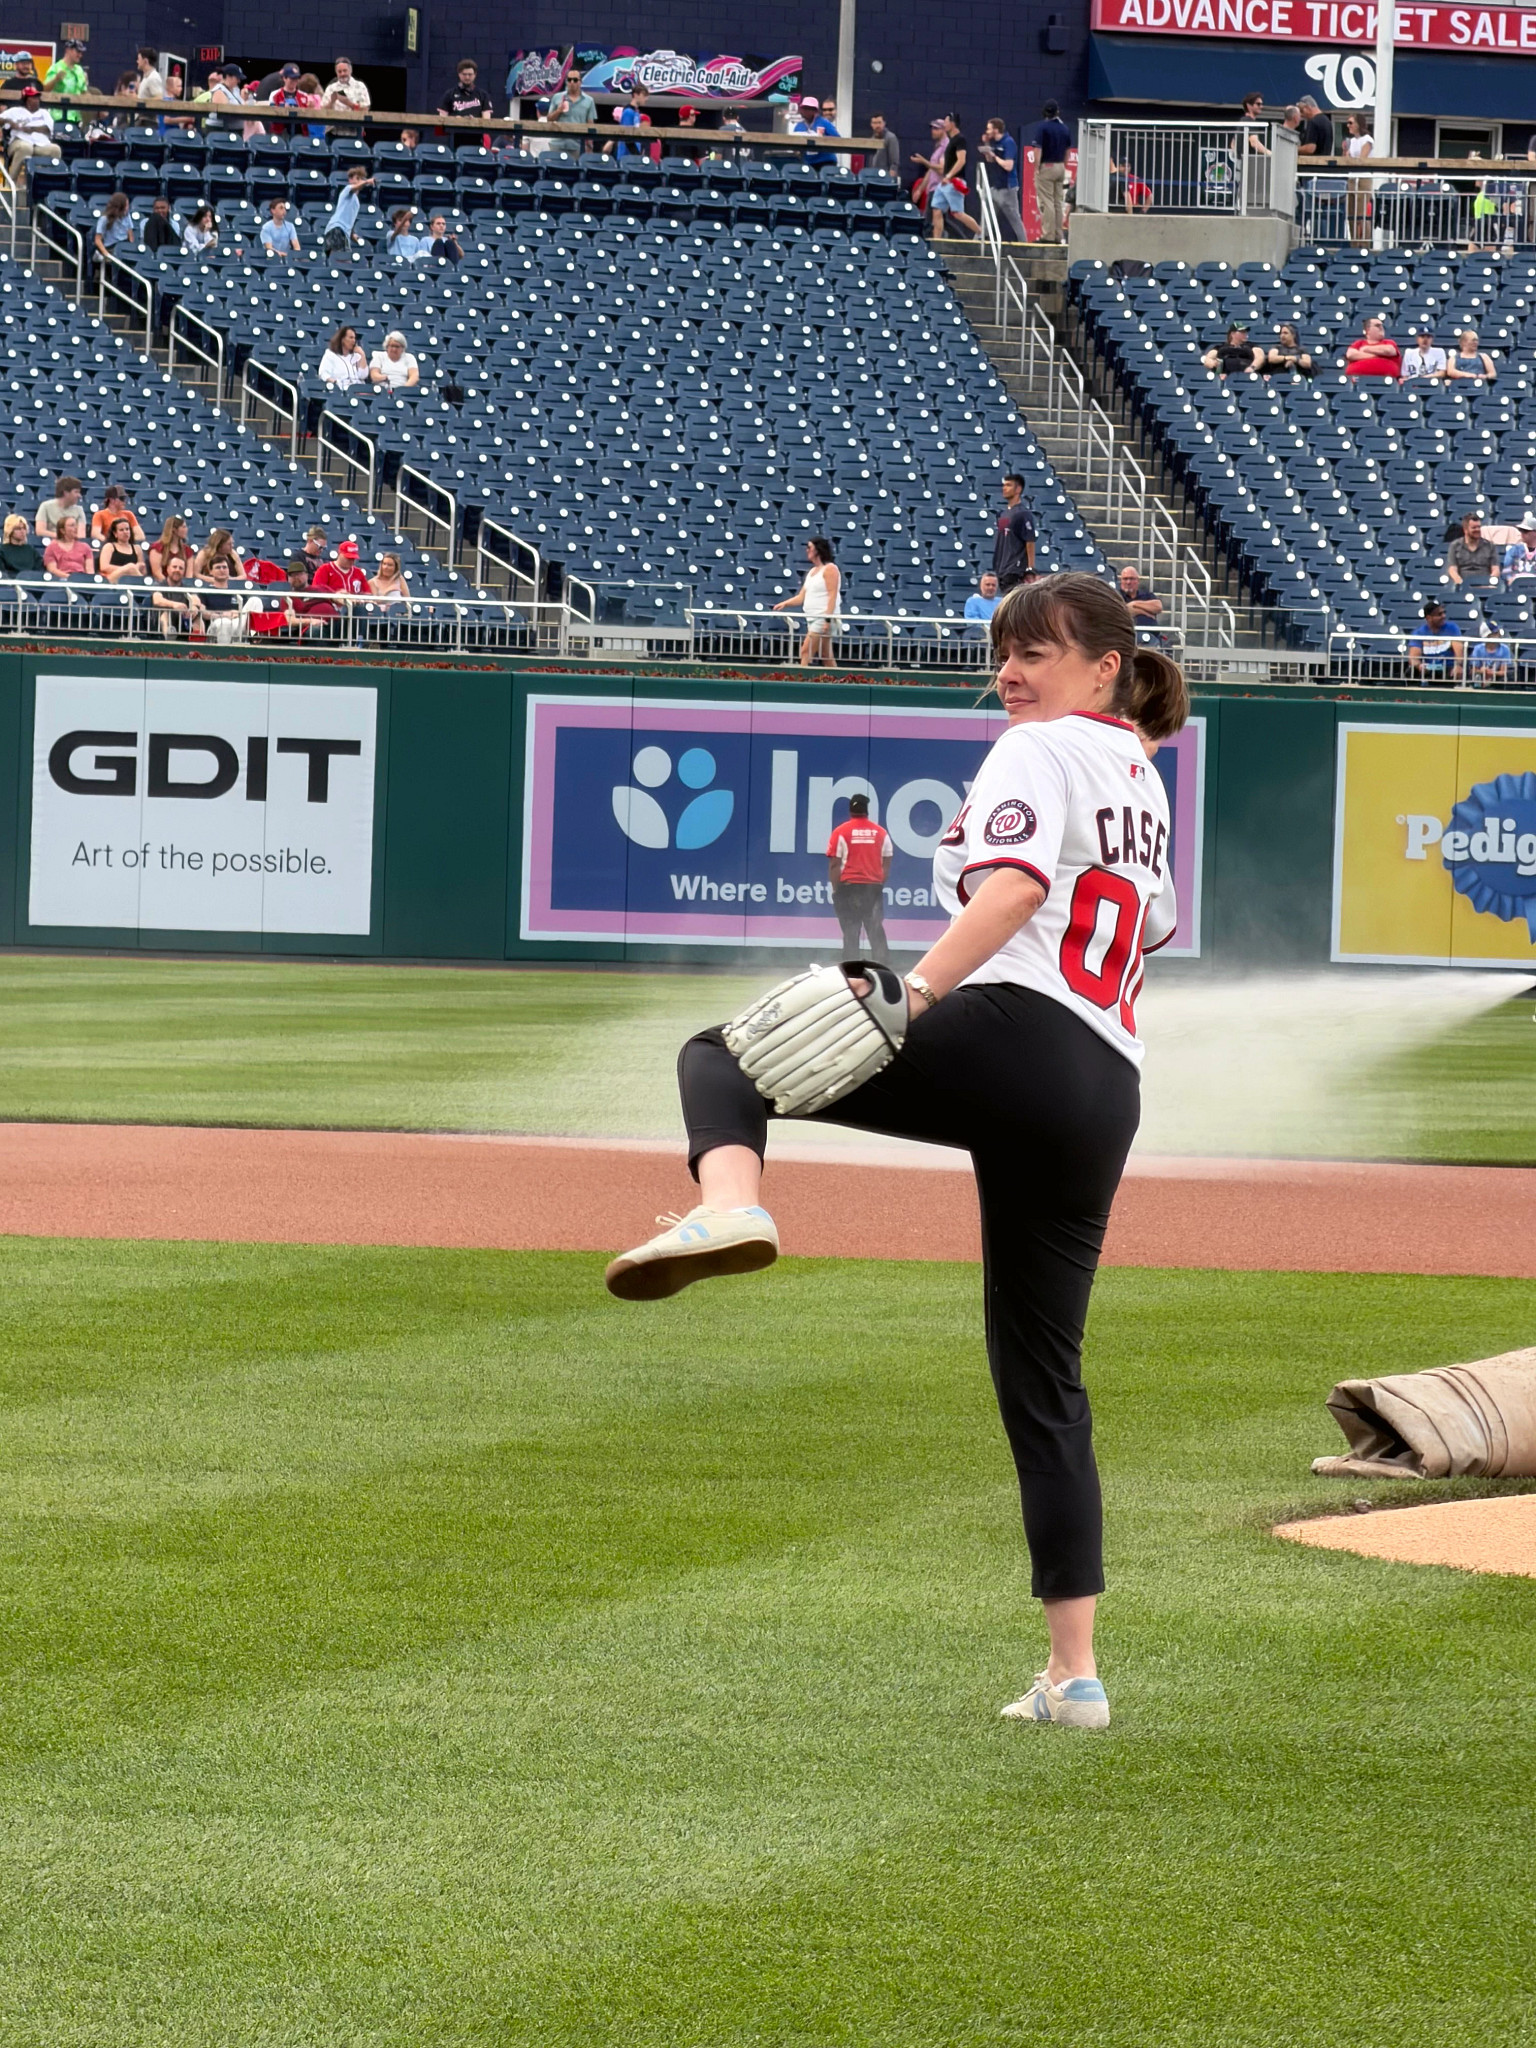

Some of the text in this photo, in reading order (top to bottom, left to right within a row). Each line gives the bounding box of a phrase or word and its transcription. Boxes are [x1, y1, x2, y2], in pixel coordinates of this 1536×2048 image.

[1119, 0, 1293, 35] ADVANCE
[1449, 10, 1536, 47] SALE
[201, 47, 219, 61] EXIT
[643, 66, 694, 84] Electric
[48, 730, 361, 803] GDIT
[770, 750, 973, 859] Ino
[988, 801, 1035, 822] WASHINGTON
[72, 841, 332, 877] Art of the possible.
[1096, 806, 1169, 880] CASE
[670, 874, 767, 902] Where
[776, 878, 834, 905] bett
